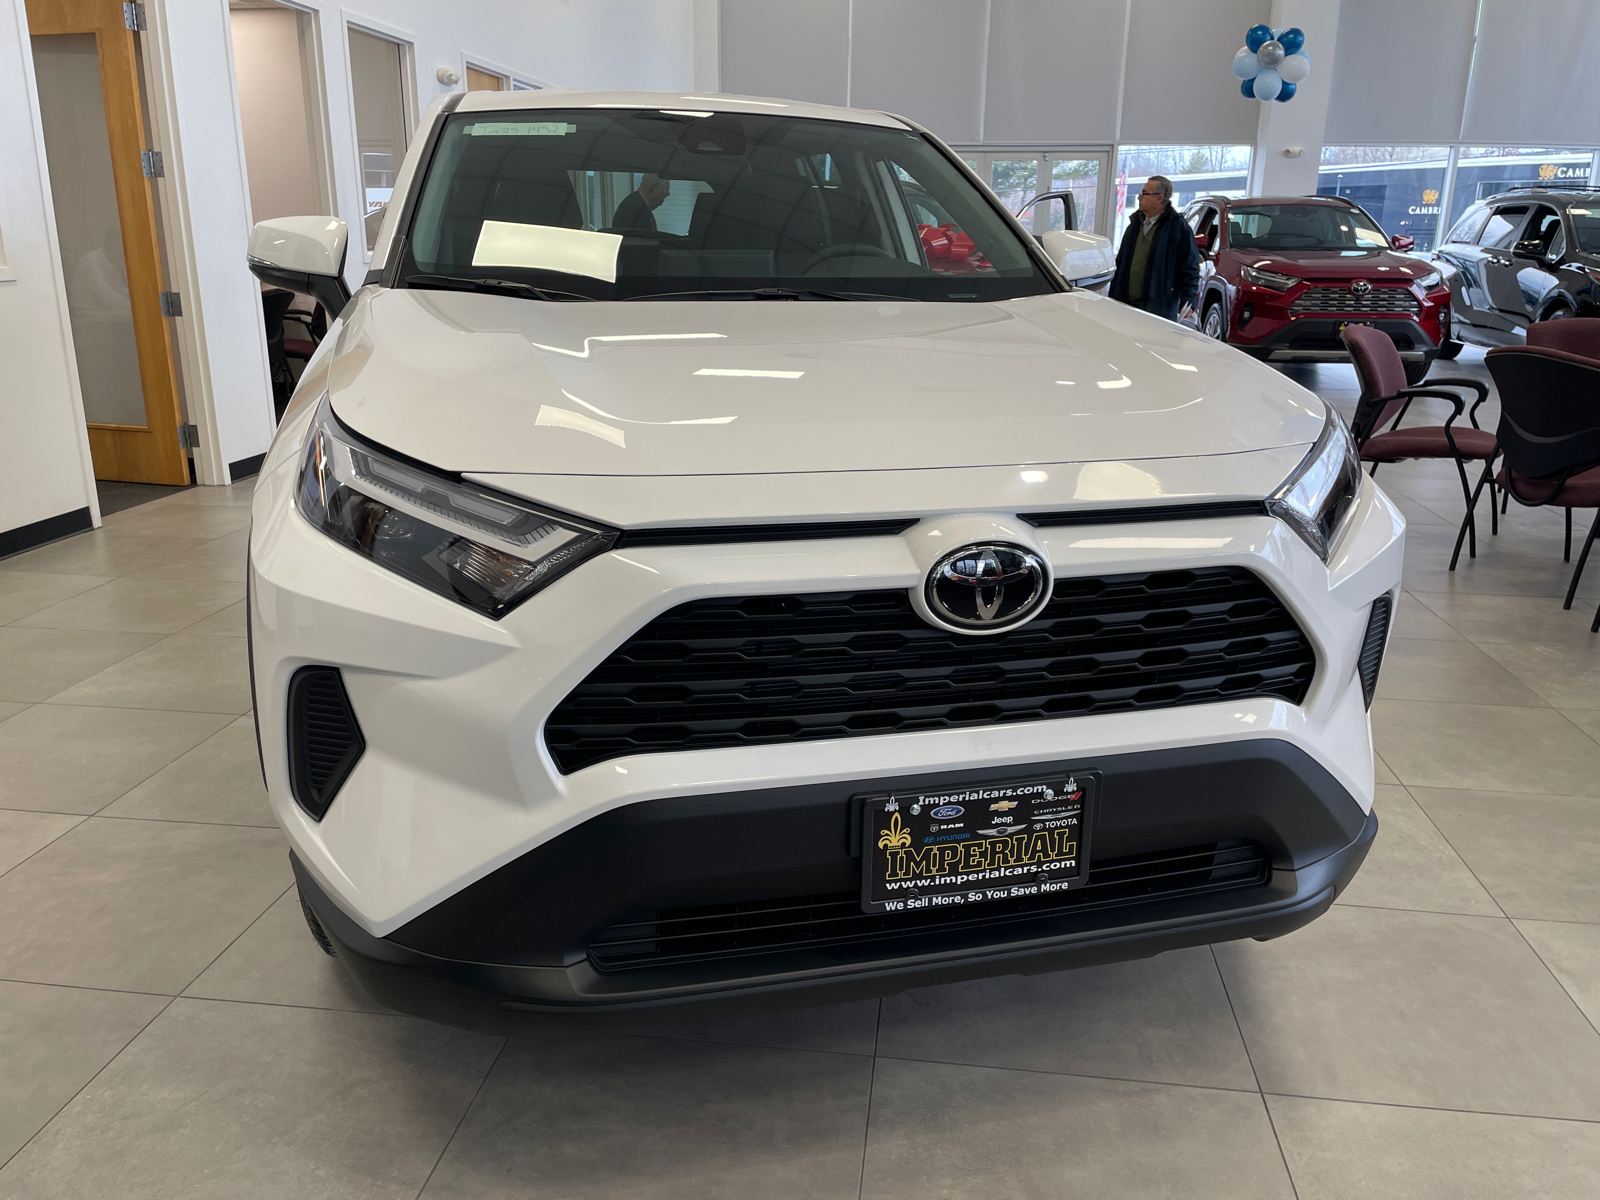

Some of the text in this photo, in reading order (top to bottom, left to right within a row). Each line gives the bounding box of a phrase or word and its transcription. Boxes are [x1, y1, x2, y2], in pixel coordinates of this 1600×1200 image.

[1557, 167, 1591, 178] CAMB
[918, 784, 1047, 806] Imperialcars.com
[1033, 804, 1081, 815] CHRYSLER
[991, 816, 1013, 824] Jeep
[1045, 818, 1078, 829] TOYOTA
[936, 833, 971, 842] HYUNDAI
[886, 829, 1077, 880] IMPERIAL
[885, 859, 1077, 890] www.imperialcars.com
[885, 881, 1069, 911] We Sell More, So You Save More
